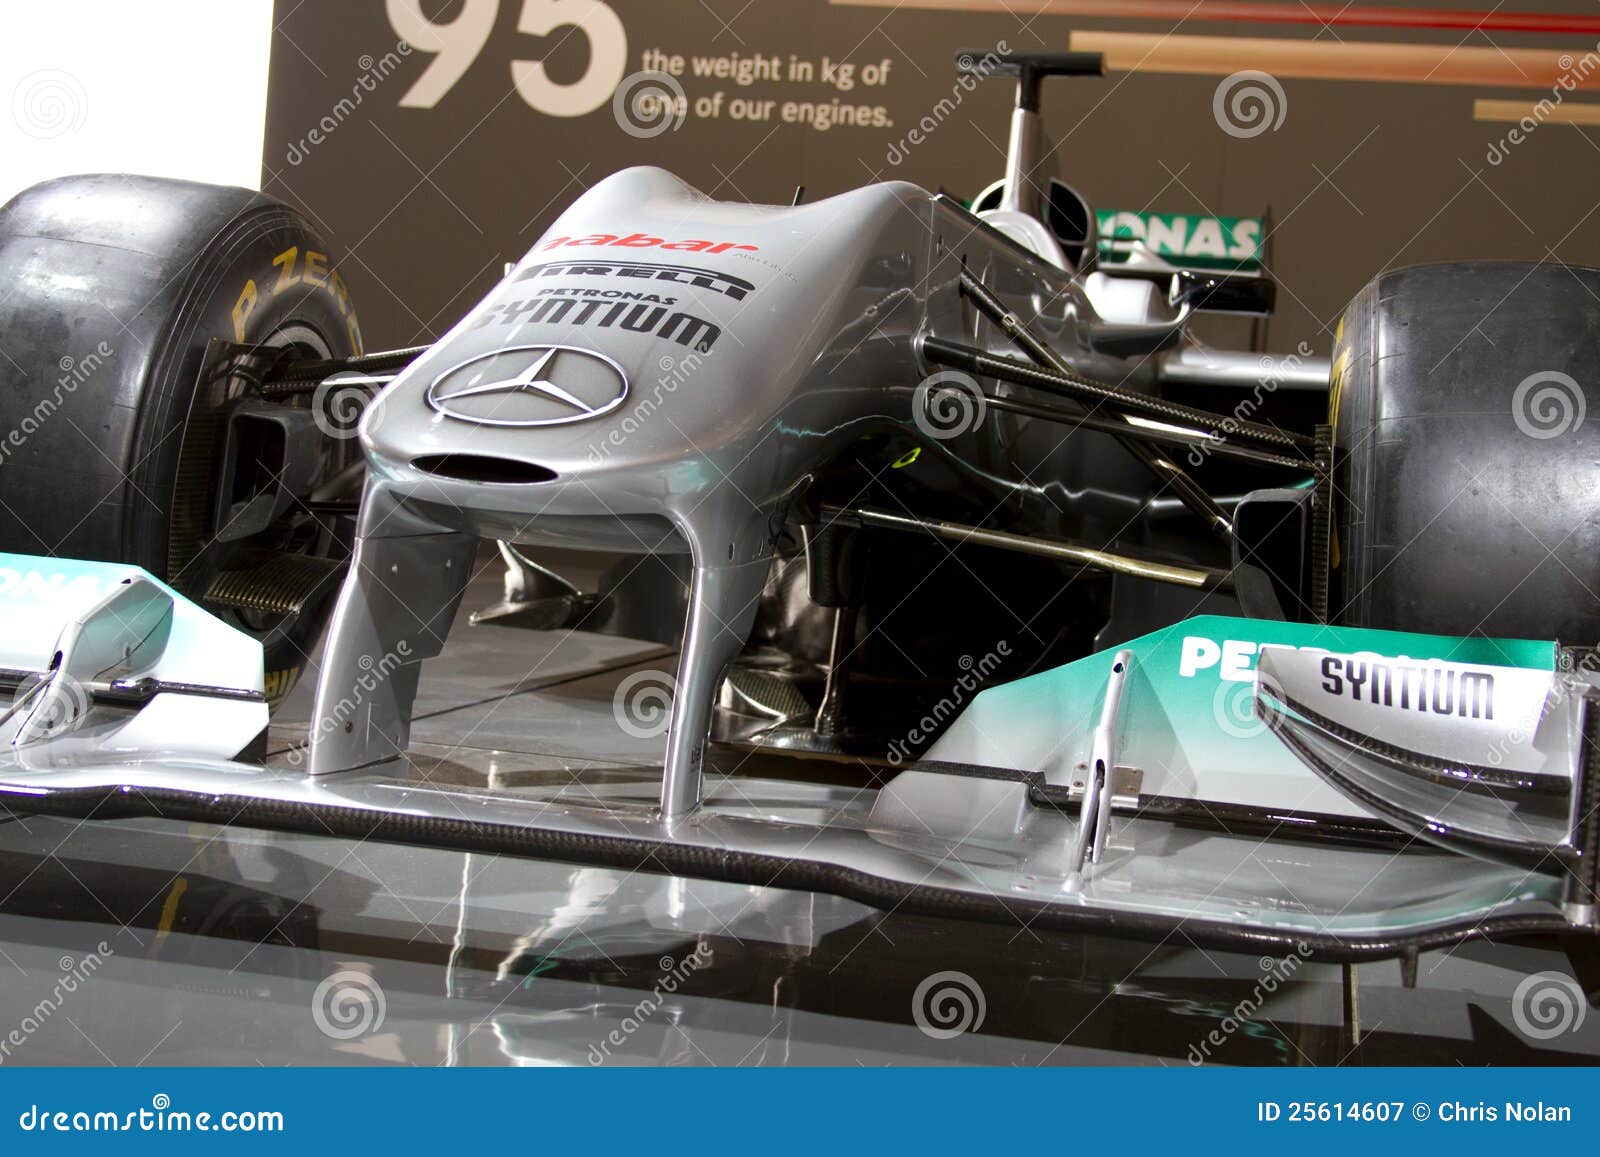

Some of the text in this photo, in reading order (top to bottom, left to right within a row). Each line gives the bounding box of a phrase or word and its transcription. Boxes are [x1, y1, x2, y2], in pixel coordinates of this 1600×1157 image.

[384, 0, 628, 117] 95
[642, 49, 892, 91] the weight in kg of
[639, 91, 894, 131] one of our engines.
[1100, 211, 1261, 260] ONAS
[511, 260, 756, 301] PIRELLI
[537, 288, 678, 306] PETRONAS
[470, 298, 722, 355] SYNTIUM
[1321, 655, 1495, 721] SYNTIUM
